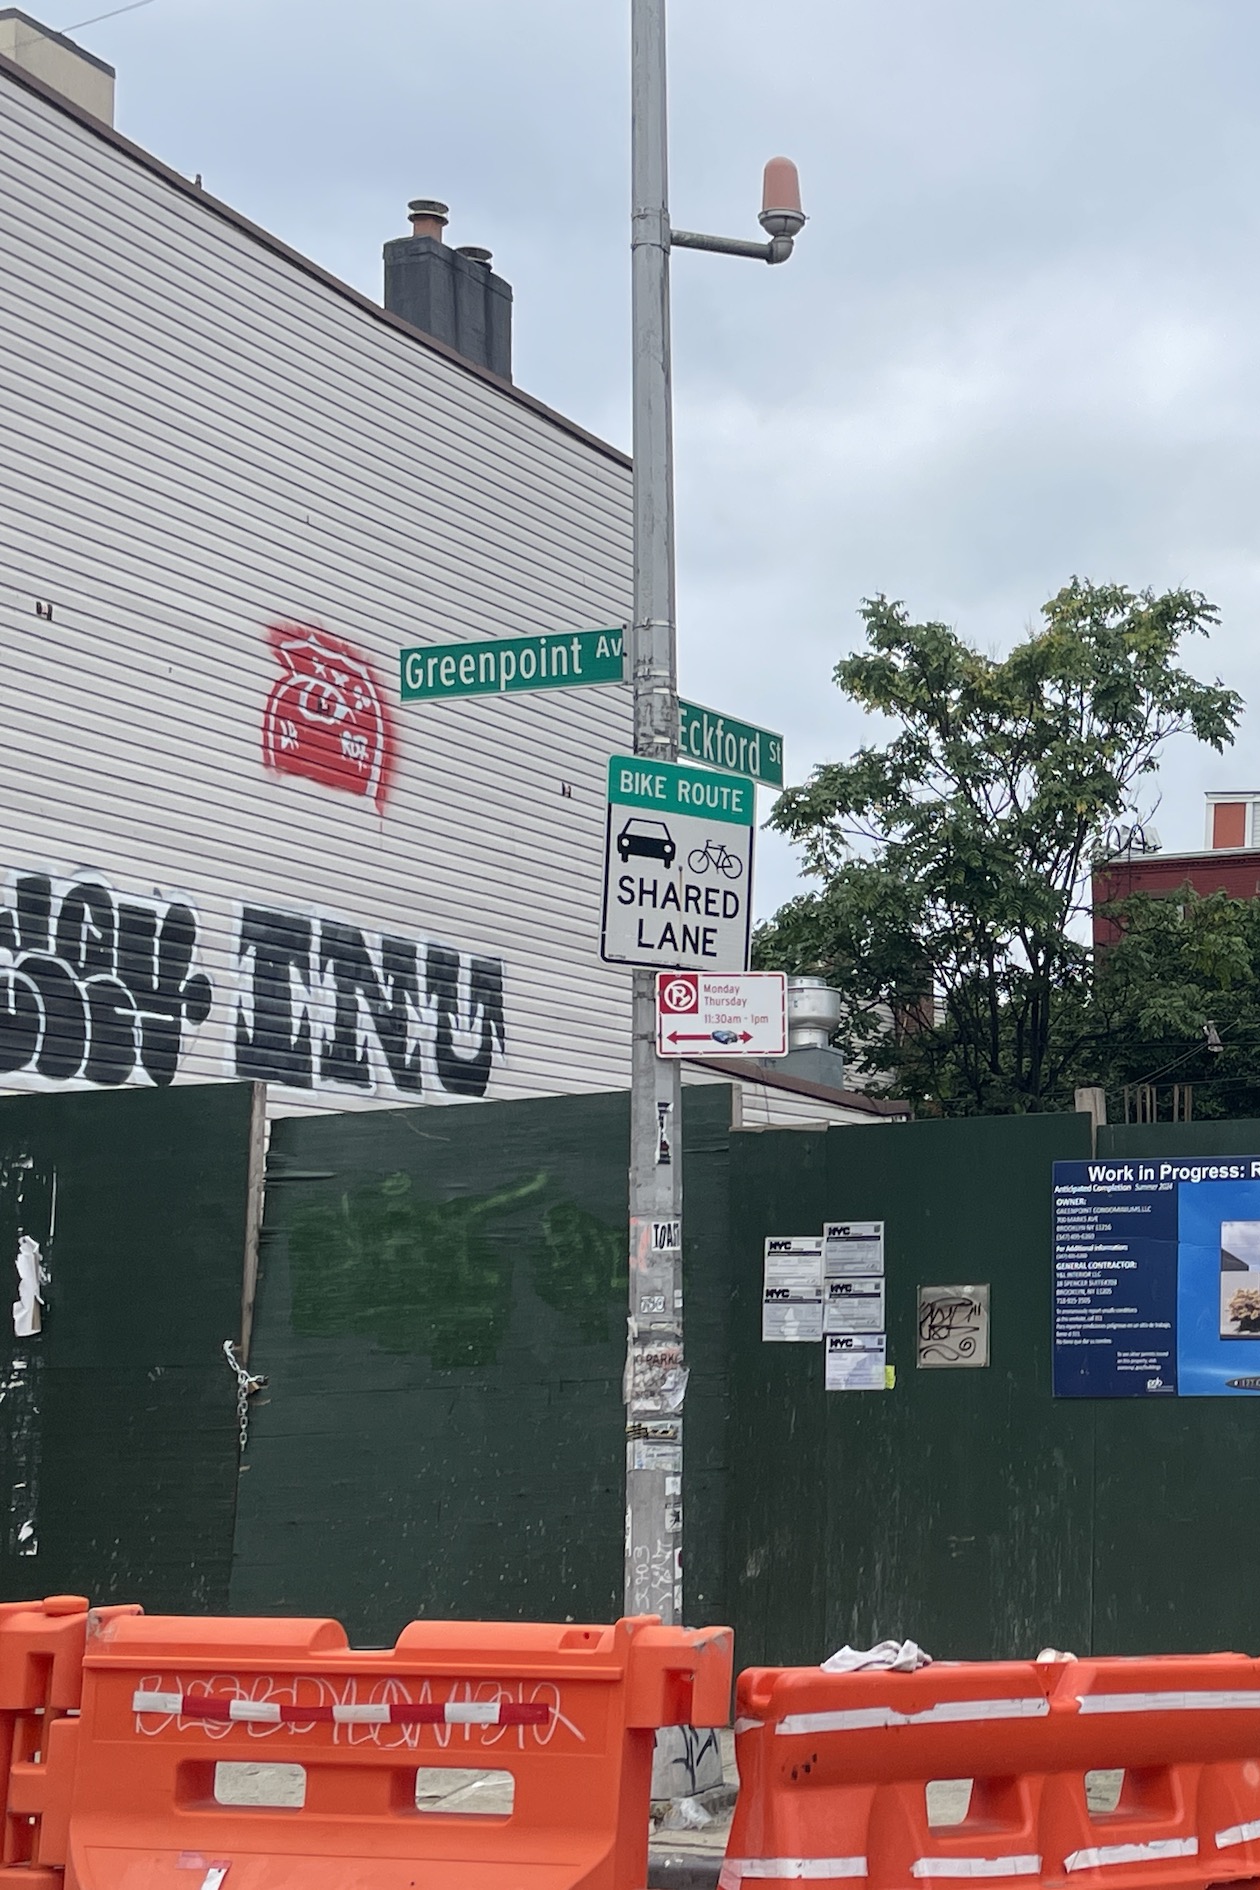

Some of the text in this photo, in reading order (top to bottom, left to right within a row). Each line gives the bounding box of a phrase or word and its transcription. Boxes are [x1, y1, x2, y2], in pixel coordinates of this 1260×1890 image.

[405, 635, 622, 691] Greenpoint Av
[678, 708, 782, 776] Eckford St
[620, 769, 744, 813] BIKE ROUTE
[617, 875, 739, 919] SHARED
[637, 918, 717, 957] LANE
[704, 984, 740, 994] Monday
[704, 996, 748, 1007] Thursday
[704, 1014, 741, 1024] 11:30am
[751, 1014, 769, 1025] 1pm
[1088, 1165, 1134, 1182] Work
[1138, 1164, 1155, 1181] in
[1160, 1164, 1246, 1183] Progress:
[1054, 1185, 1091, 1194] Anticipated
[1093, 1184, 1132, 1193] Completion
[1056, 1198, 1087, 1206] OWNER:
[828, 1227, 850, 1236] NYC
[769, 1241, 791, 1250] NYC
[1056, 1261, 1137, 1270] GENERAL CONTRACTOR:
[766, 1289, 790, 1298] NYC
[830, 1284, 852, 1293] NYC
[830, 1338, 853, 1348] NYC
